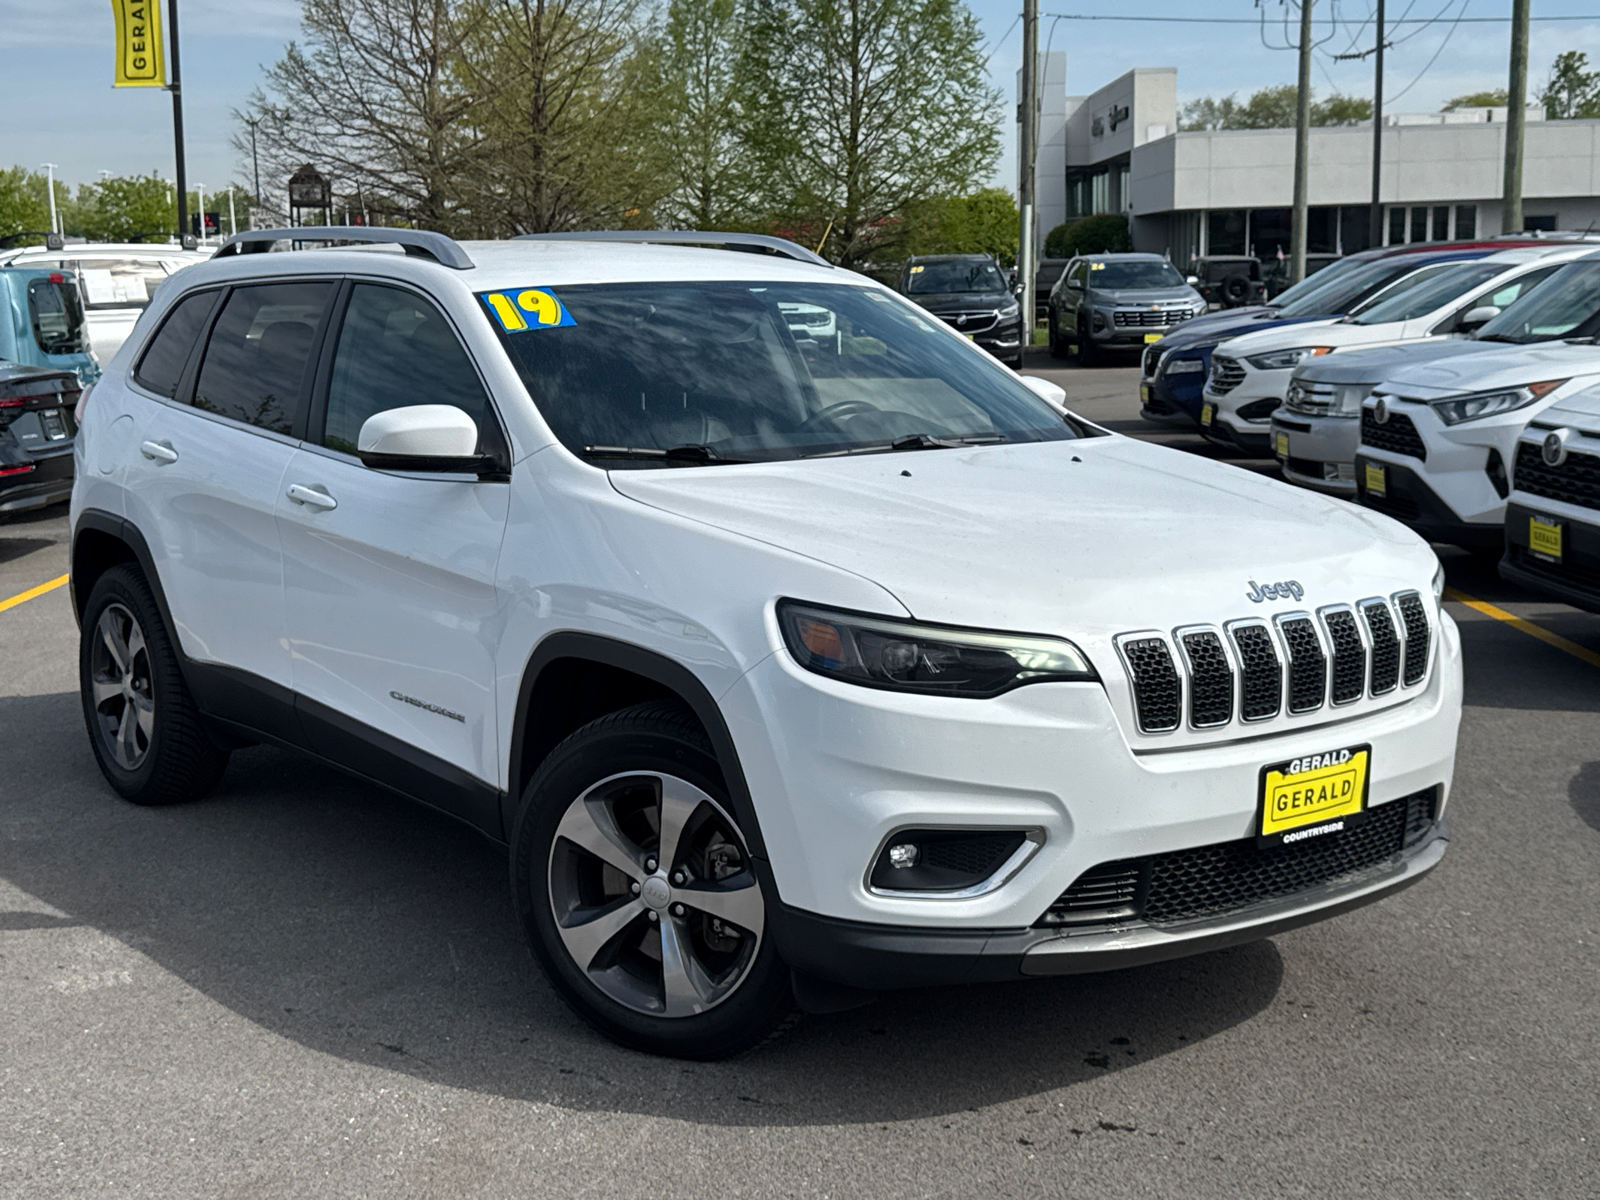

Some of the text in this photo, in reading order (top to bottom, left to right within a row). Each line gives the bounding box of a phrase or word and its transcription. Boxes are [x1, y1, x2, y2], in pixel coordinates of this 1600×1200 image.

[488, 290, 562, 330] 19
[1246, 579, 1305, 603] Jeep
[1289, 749, 1350, 775] GERALD
[1277, 779, 1352, 812] GERALD
[1283, 821, 1345, 844] COUNTRYSIDE
